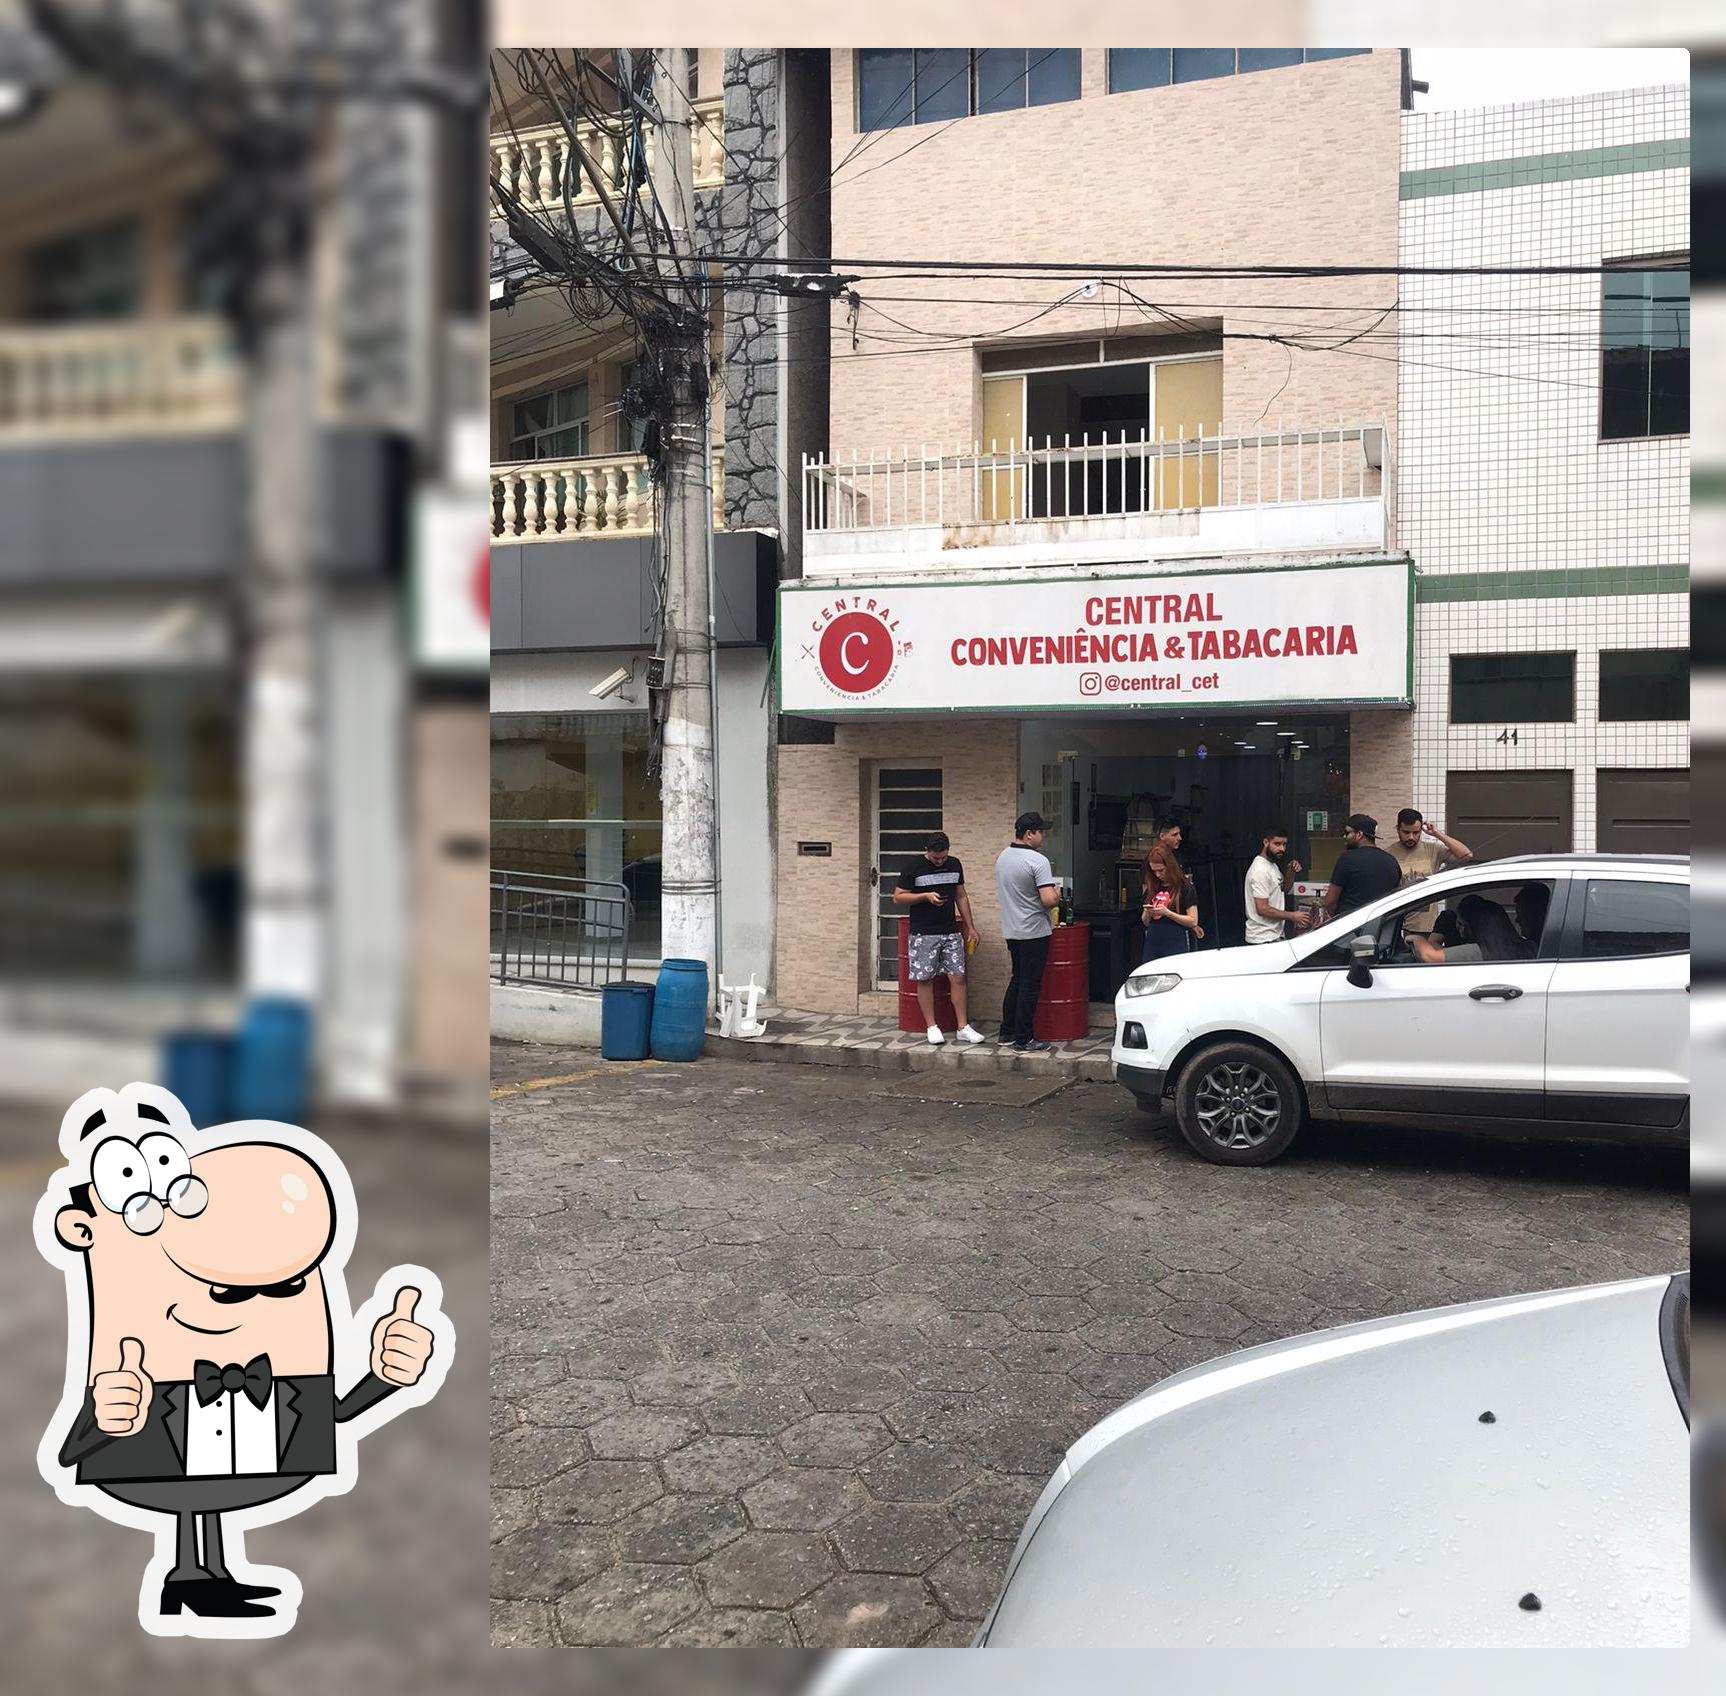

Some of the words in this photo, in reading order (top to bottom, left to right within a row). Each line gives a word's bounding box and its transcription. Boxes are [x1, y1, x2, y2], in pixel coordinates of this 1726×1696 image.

[811, 596, 901, 633] CENTRAL
[1084, 592, 1223, 627] CENTRAL
[841, 631, 870, 676] C
[950, 627, 1159, 668] CONVENIÊNCIA
[1163, 635, 1185, 659] &
[1187, 625, 1358, 661] TABACARIA
[1103, 670, 1221, 694] @central_cet
[1496, 728, 1518, 746] 41
